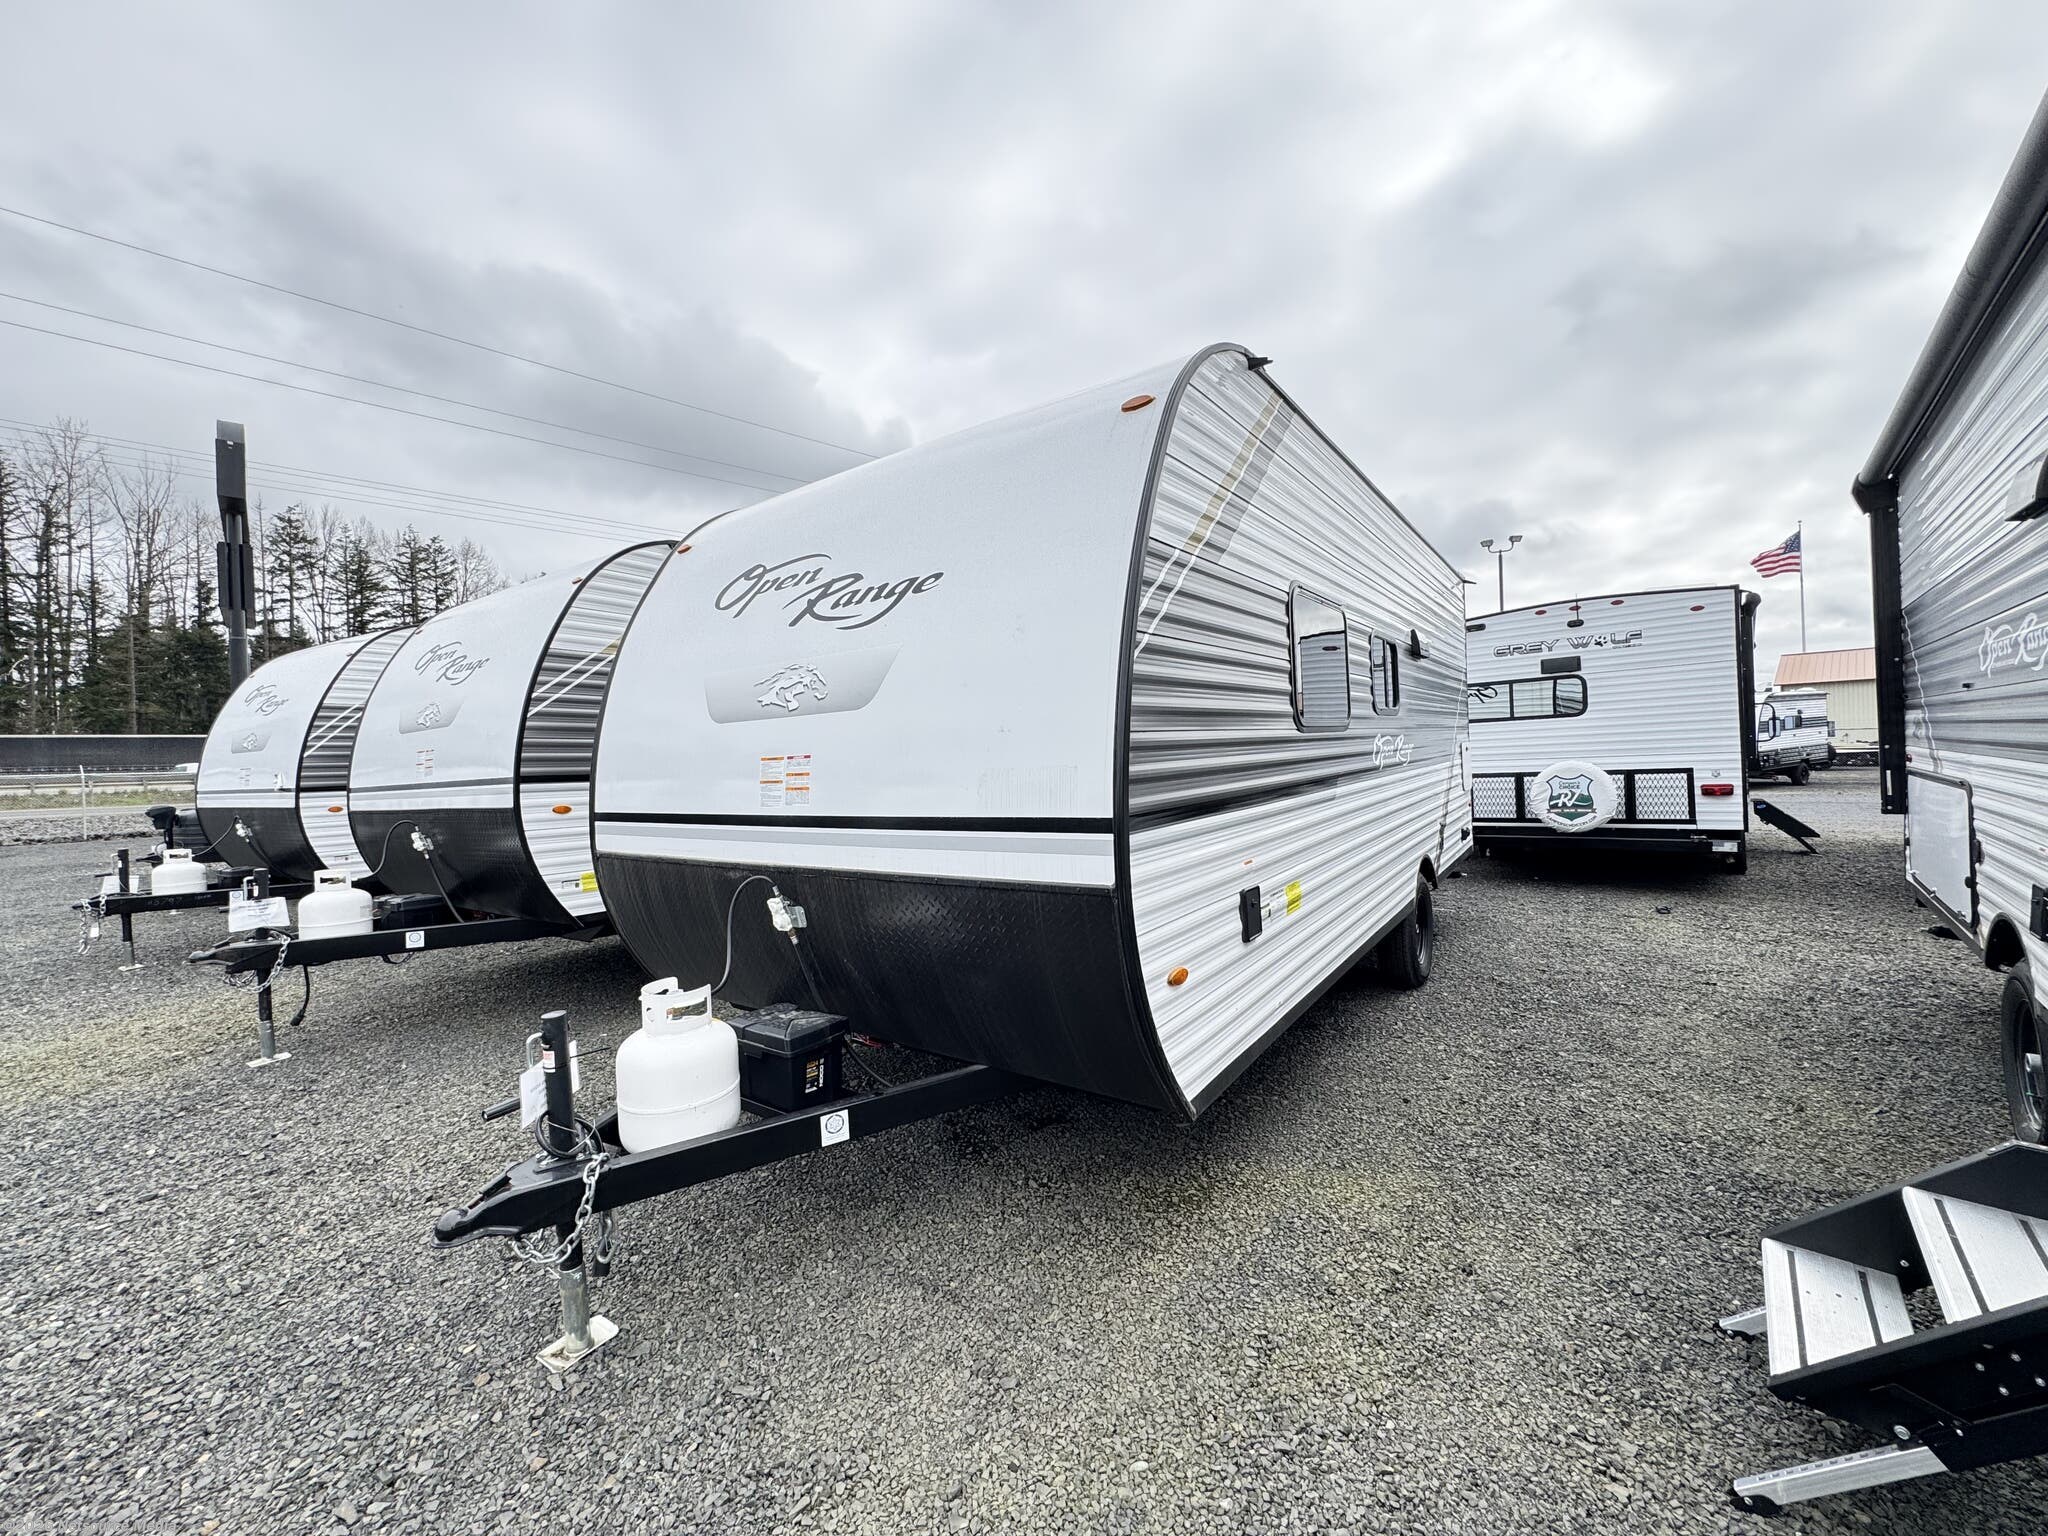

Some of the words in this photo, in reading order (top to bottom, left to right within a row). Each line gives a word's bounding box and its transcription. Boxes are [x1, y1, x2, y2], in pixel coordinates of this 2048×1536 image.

[715, 553, 832, 618] Open
[782, 572, 944, 630] Range
[415, 641, 462, 675] Open
[1493, 638, 1560, 657] GREY
[1979, 625, 2013, 678] Open
[2013, 612, 2048, 671] Rang
[436, 655, 490, 685] Range
